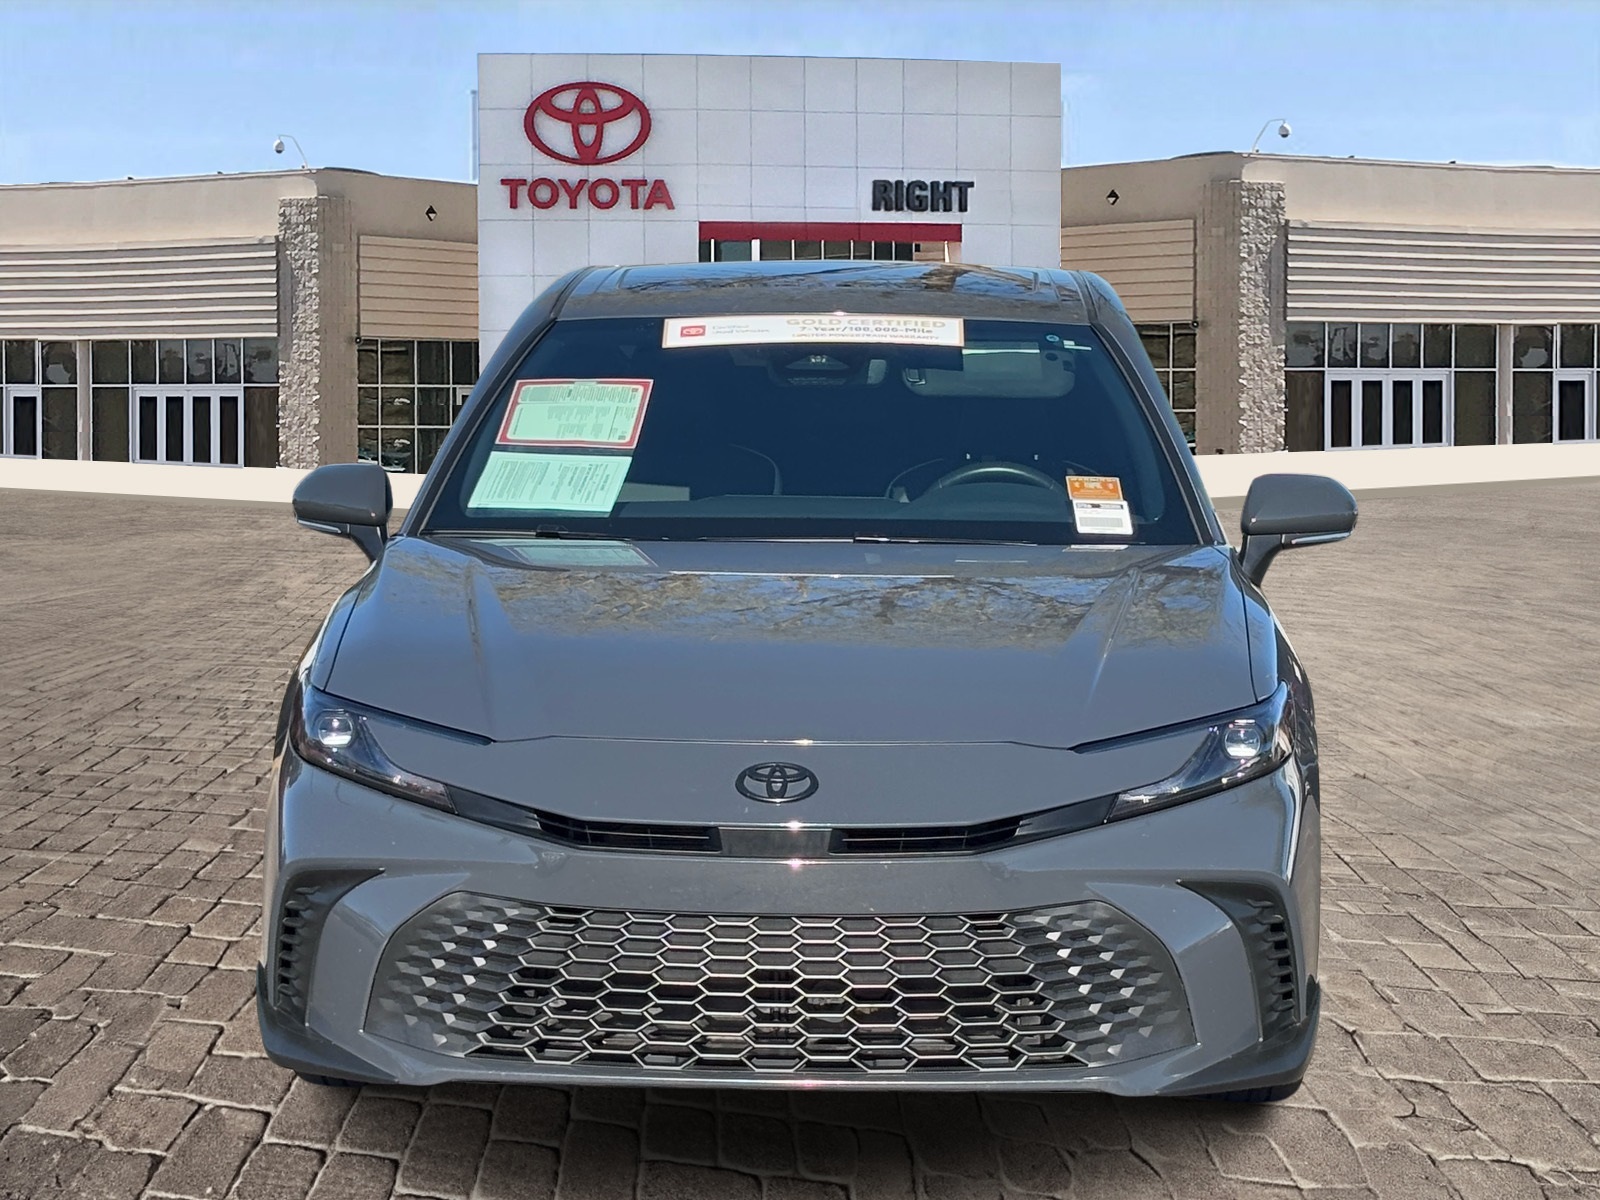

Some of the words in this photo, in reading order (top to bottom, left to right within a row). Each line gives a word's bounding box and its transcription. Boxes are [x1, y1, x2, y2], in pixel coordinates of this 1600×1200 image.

[501, 179, 675, 209] TOYOTA
[872, 180, 975, 212] RIGHT
[847, 319, 946, 328] CERTIFIED
